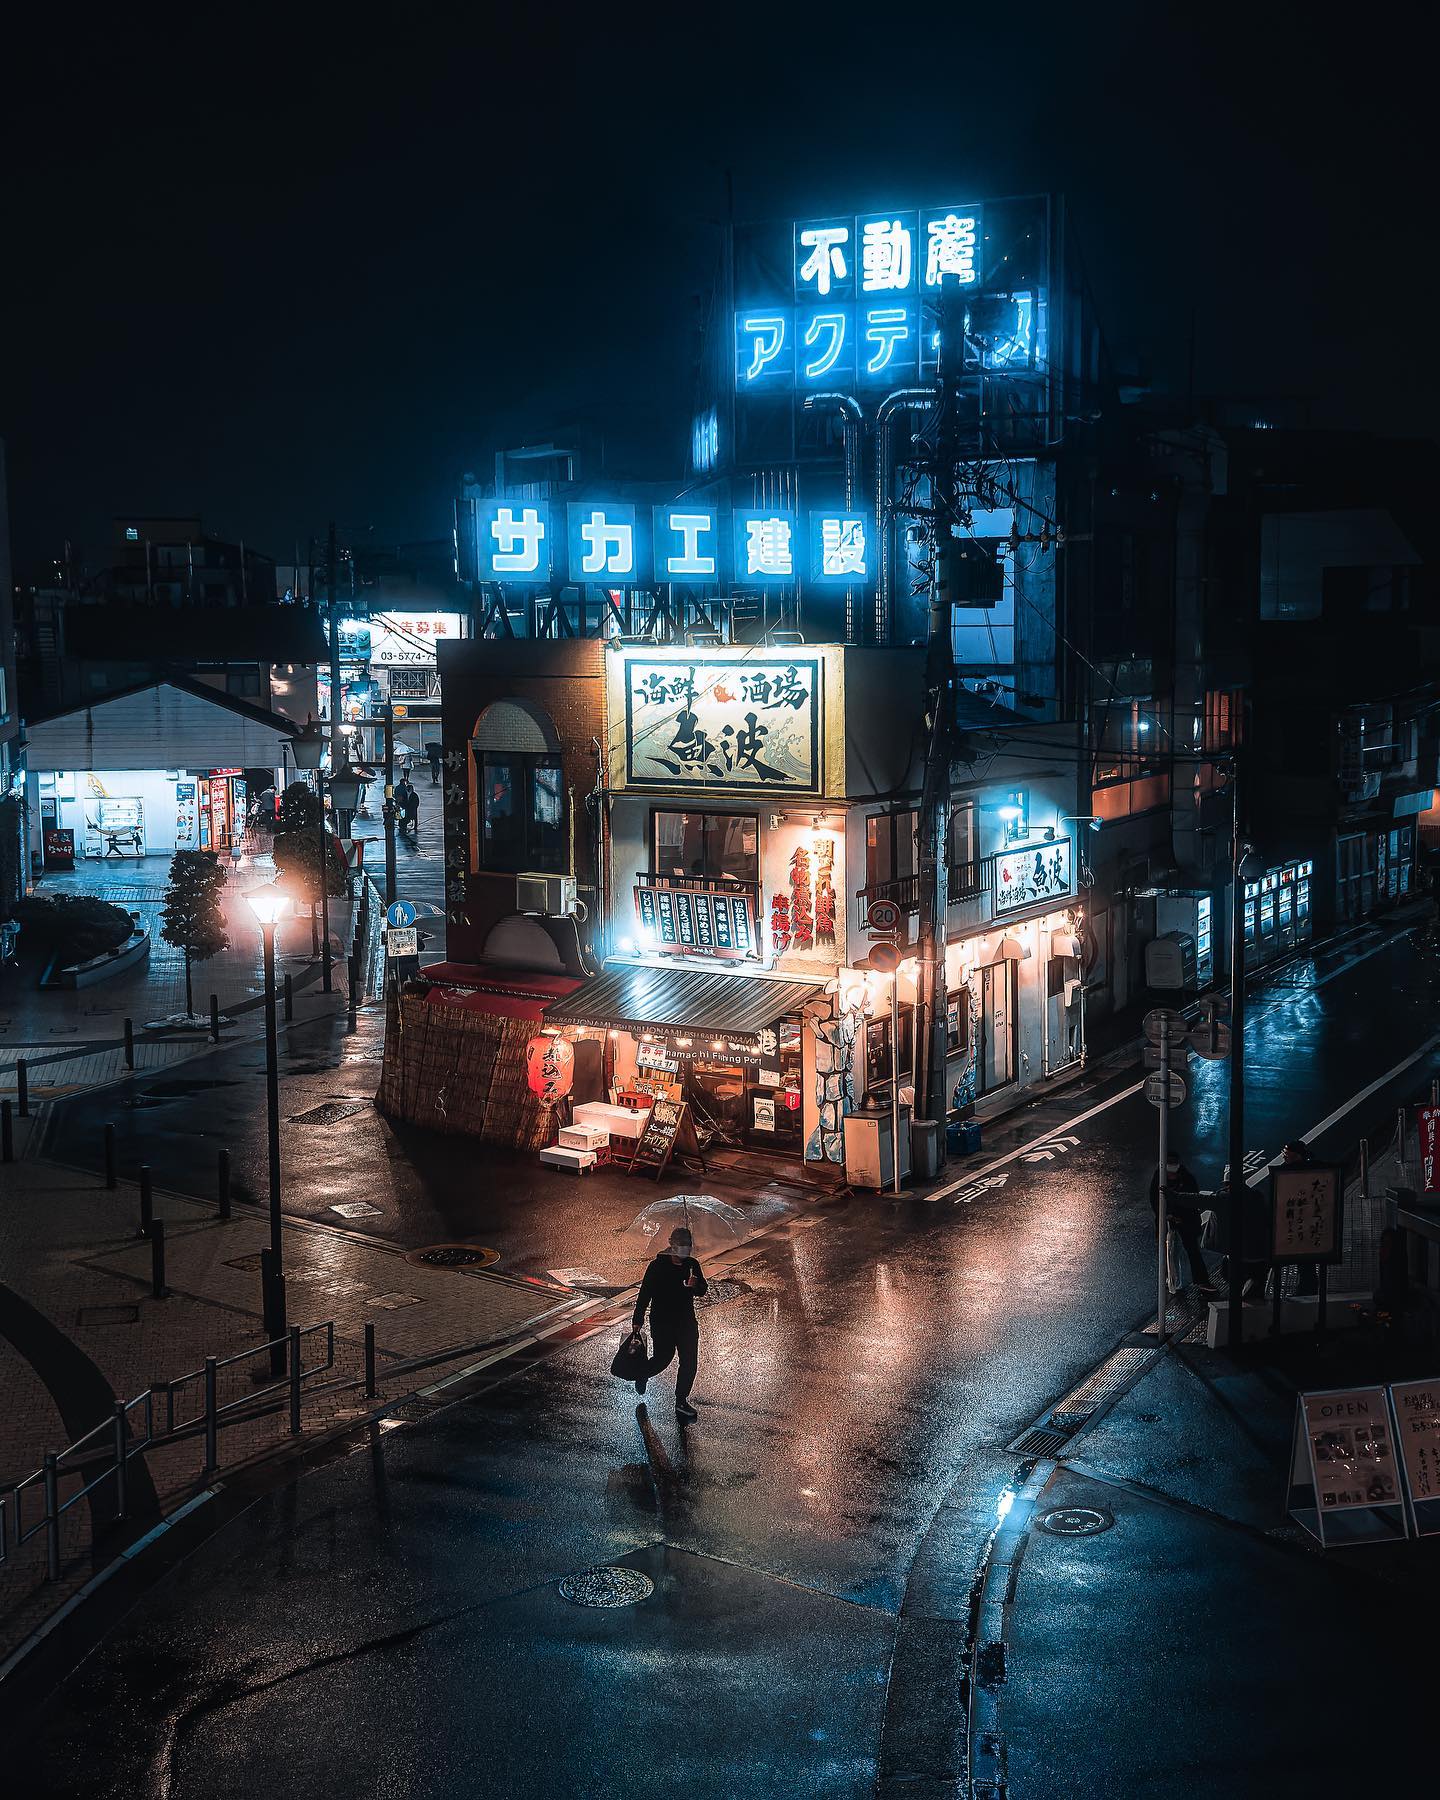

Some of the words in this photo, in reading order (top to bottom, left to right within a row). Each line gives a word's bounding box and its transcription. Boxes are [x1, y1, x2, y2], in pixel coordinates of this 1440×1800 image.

[800, 215, 976, 295] 不動産
[491, 507, 867, 576] サカエ建設
[633, 666, 700, 713] 海鮮
[740, 665, 810, 711] 酒場
[645, 710, 797, 782] 魚波
[1026, 848, 1069, 898] 魚波
[875, 910, 893, 923] 20
[573, 1017, 611, 1029] UONAMI
[641, 1025, 682, 1038] UONAMI
[714, 1033, 756, 1046] UONAMI
[744, 1054, 762, 1067] Port
[1321, 1401, 1369, 1417] OPEN
